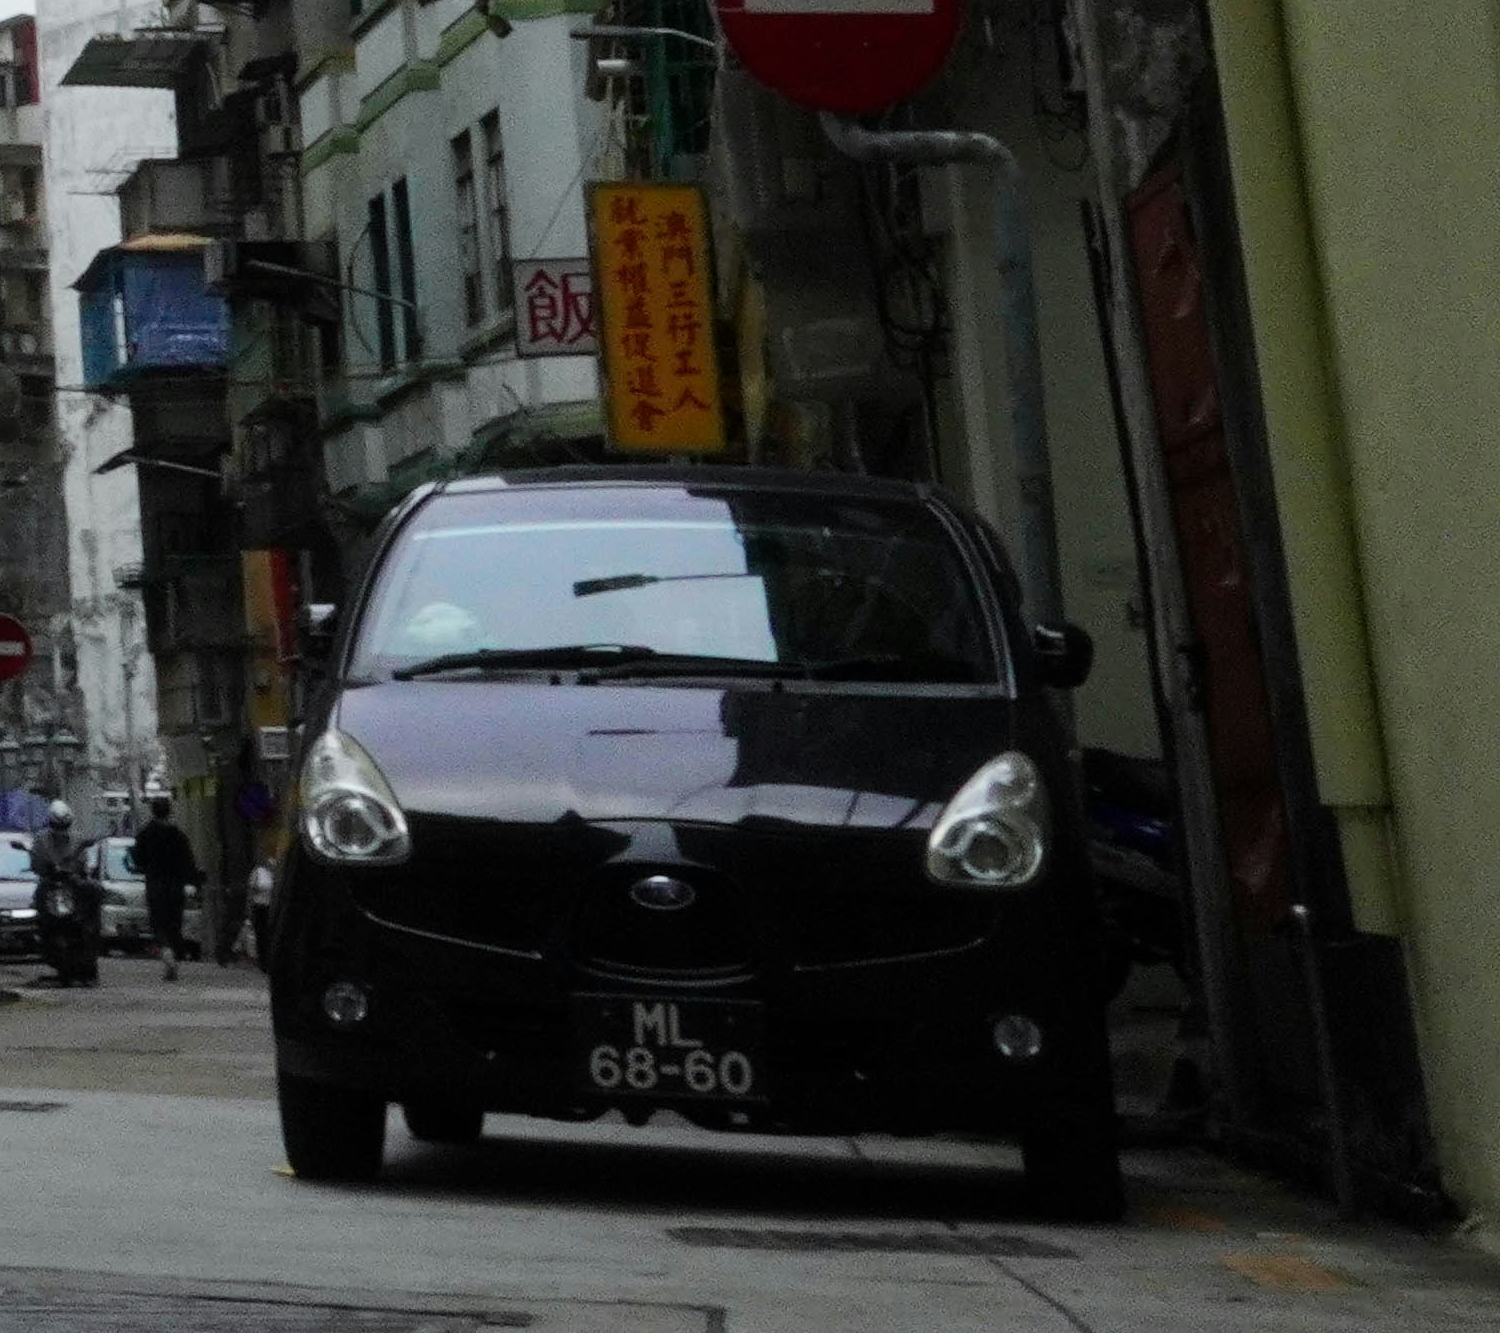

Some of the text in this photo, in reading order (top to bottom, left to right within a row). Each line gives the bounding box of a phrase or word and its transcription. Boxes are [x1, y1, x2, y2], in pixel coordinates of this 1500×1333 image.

[524, 268, 597, 344] 飯
[655, 210, 712, 412] 澳門三行工人
[631, 1002, 704, 1049] ML
[588, 1044, 753, 1095] 68-60
